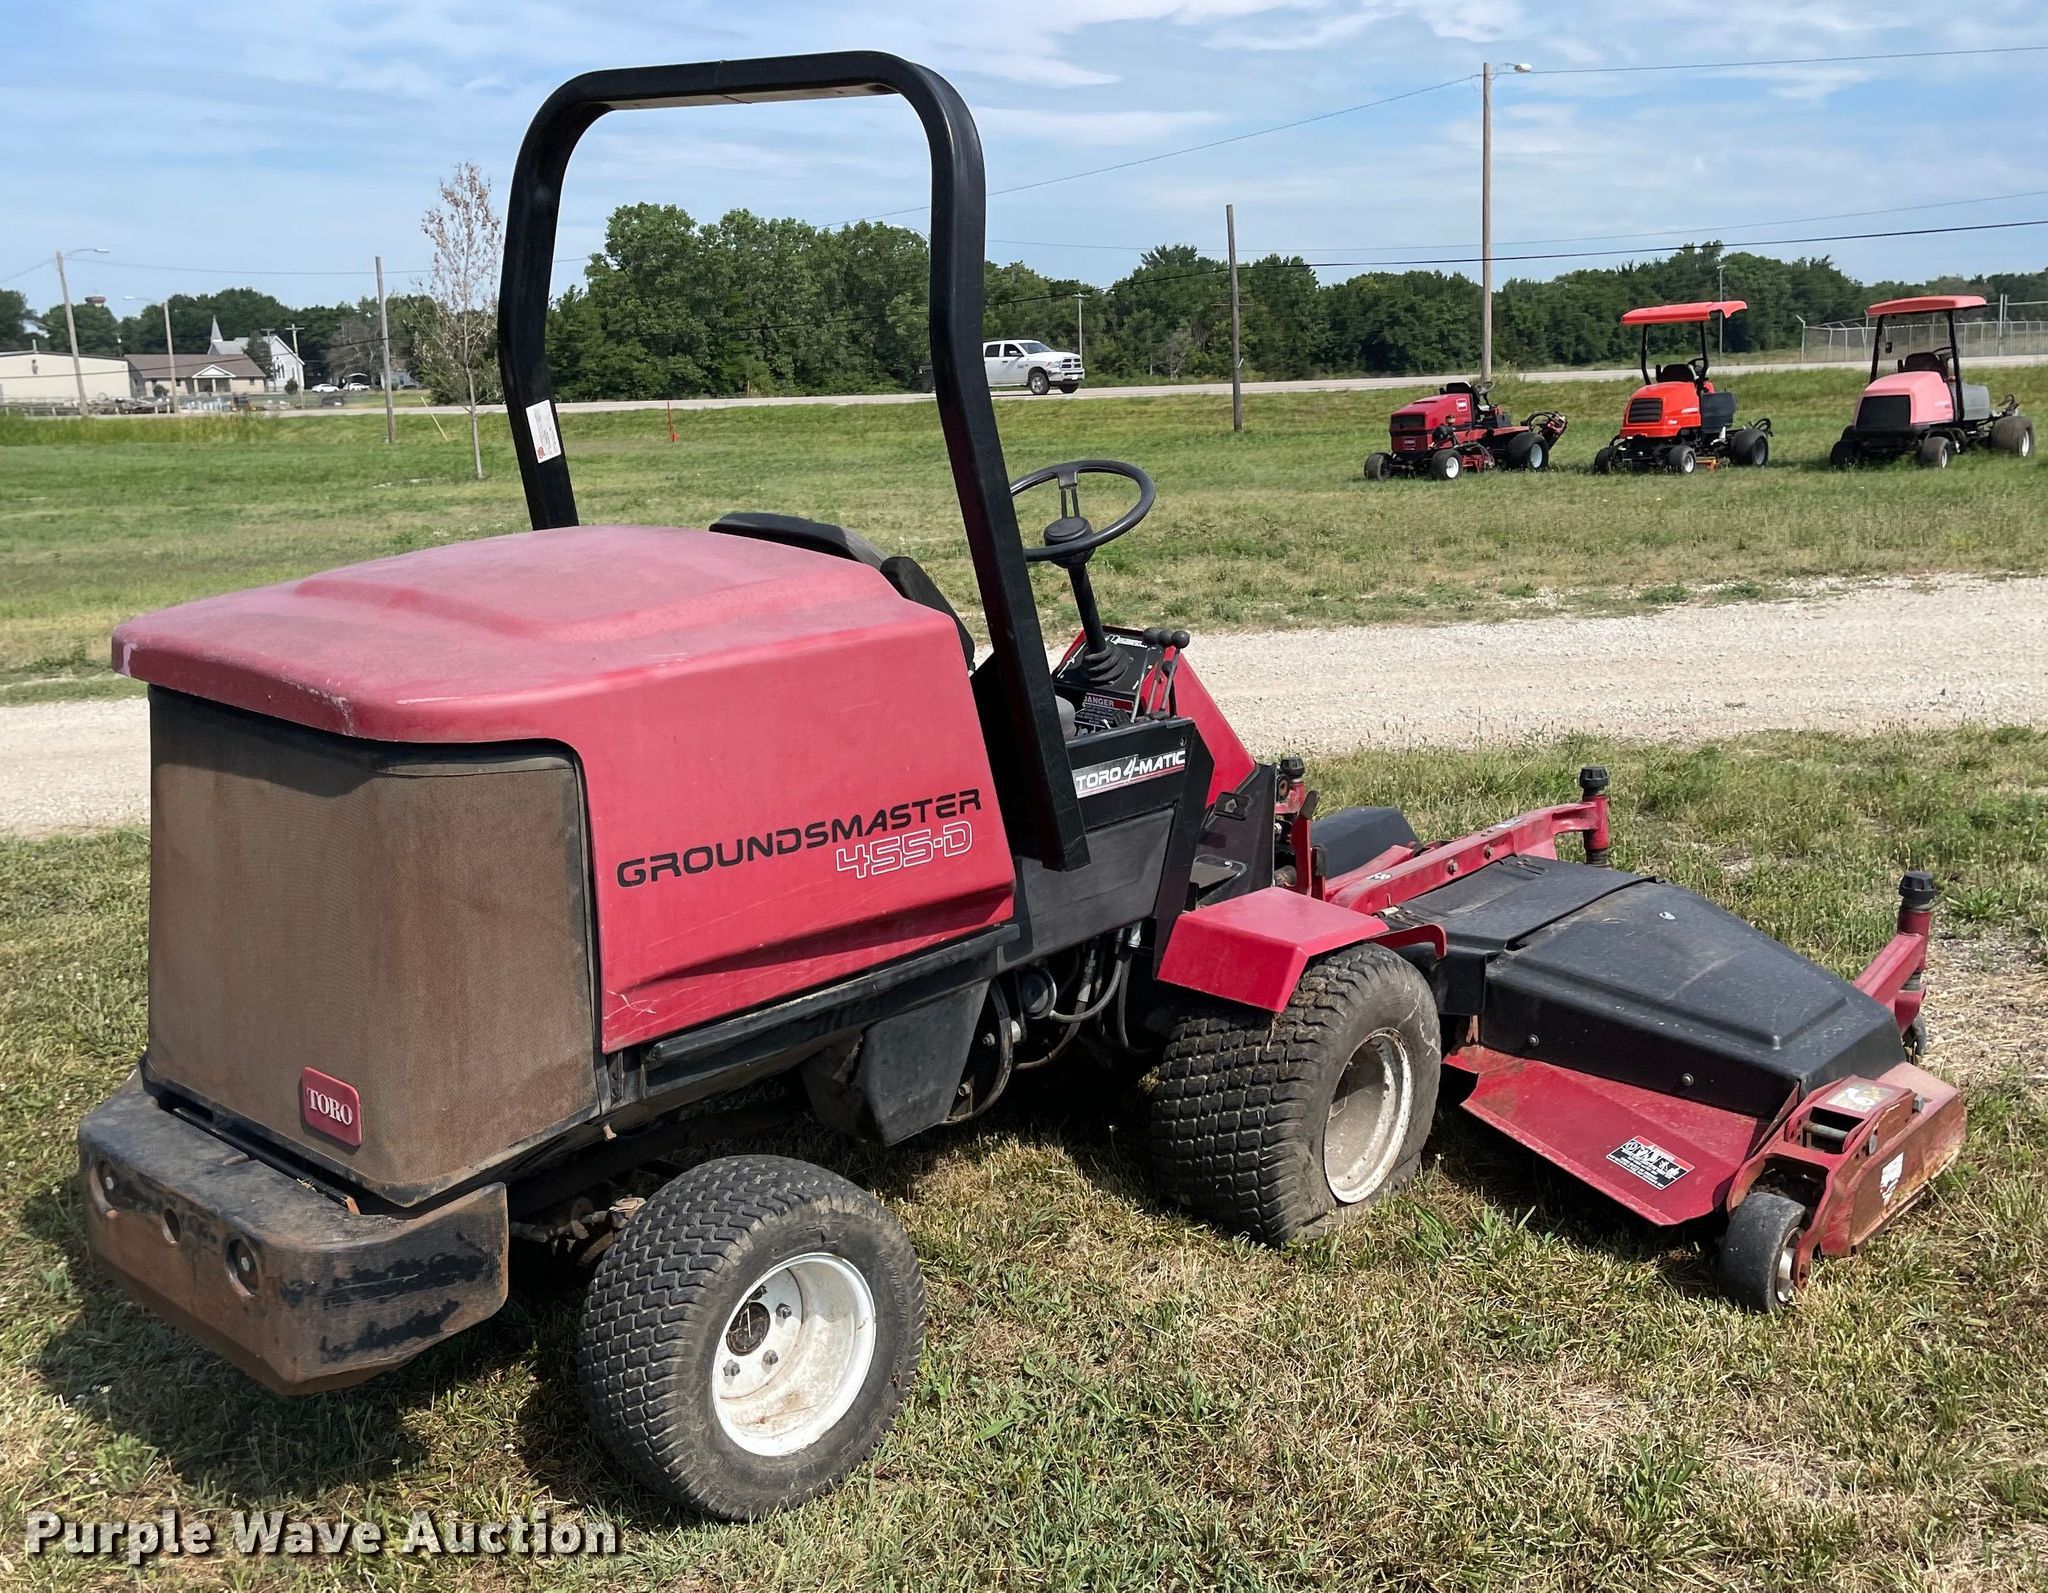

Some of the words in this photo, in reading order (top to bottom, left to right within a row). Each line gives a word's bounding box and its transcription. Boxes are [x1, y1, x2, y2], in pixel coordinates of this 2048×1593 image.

[1075, 767, 1122, 790] TORO
[616, 788, 982, 888] GROUNDSMASTER
[836, 820, 973, 878] 455-D
[306, 1088, 353, 1125] TORO
